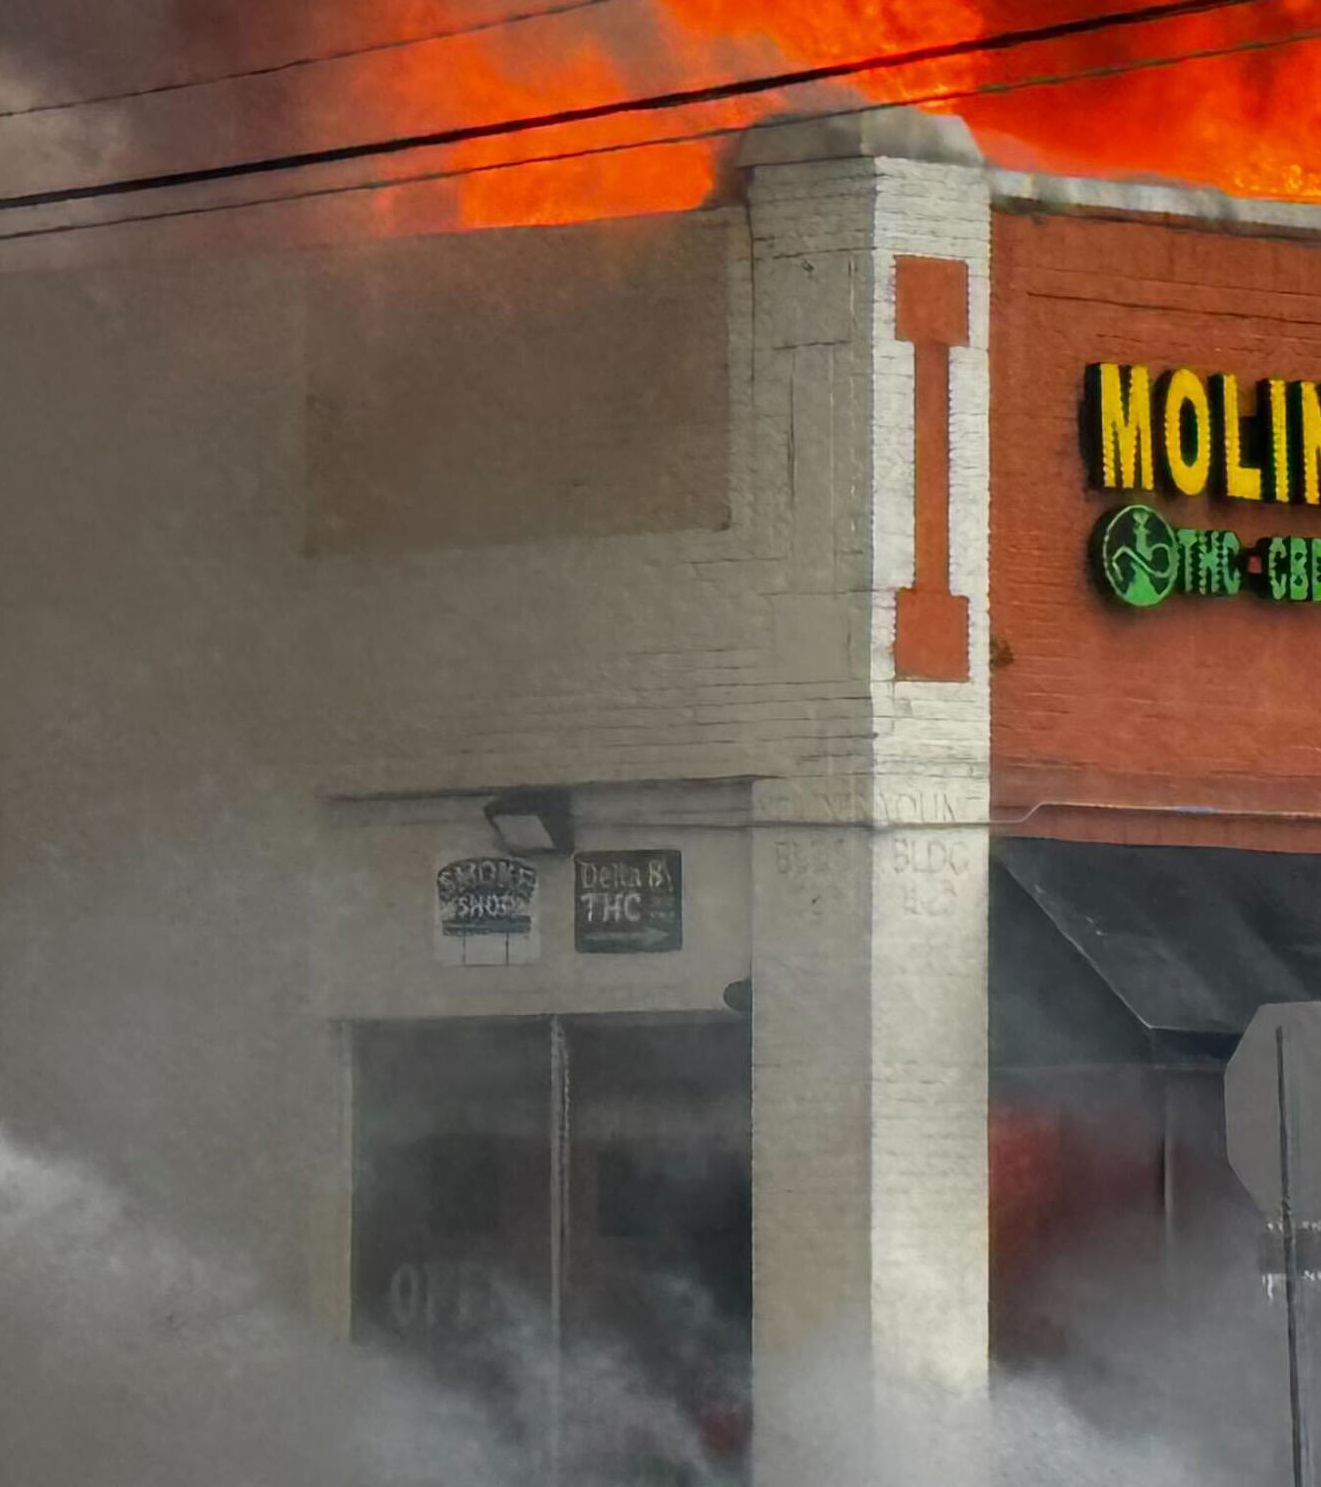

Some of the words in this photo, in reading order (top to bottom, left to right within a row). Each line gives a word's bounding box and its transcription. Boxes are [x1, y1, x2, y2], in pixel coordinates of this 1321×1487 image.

[1176, 527, 1242, 595] THC
[438, 860, 535, 893] SMOKE
[580, 892, 642, 923] THC
